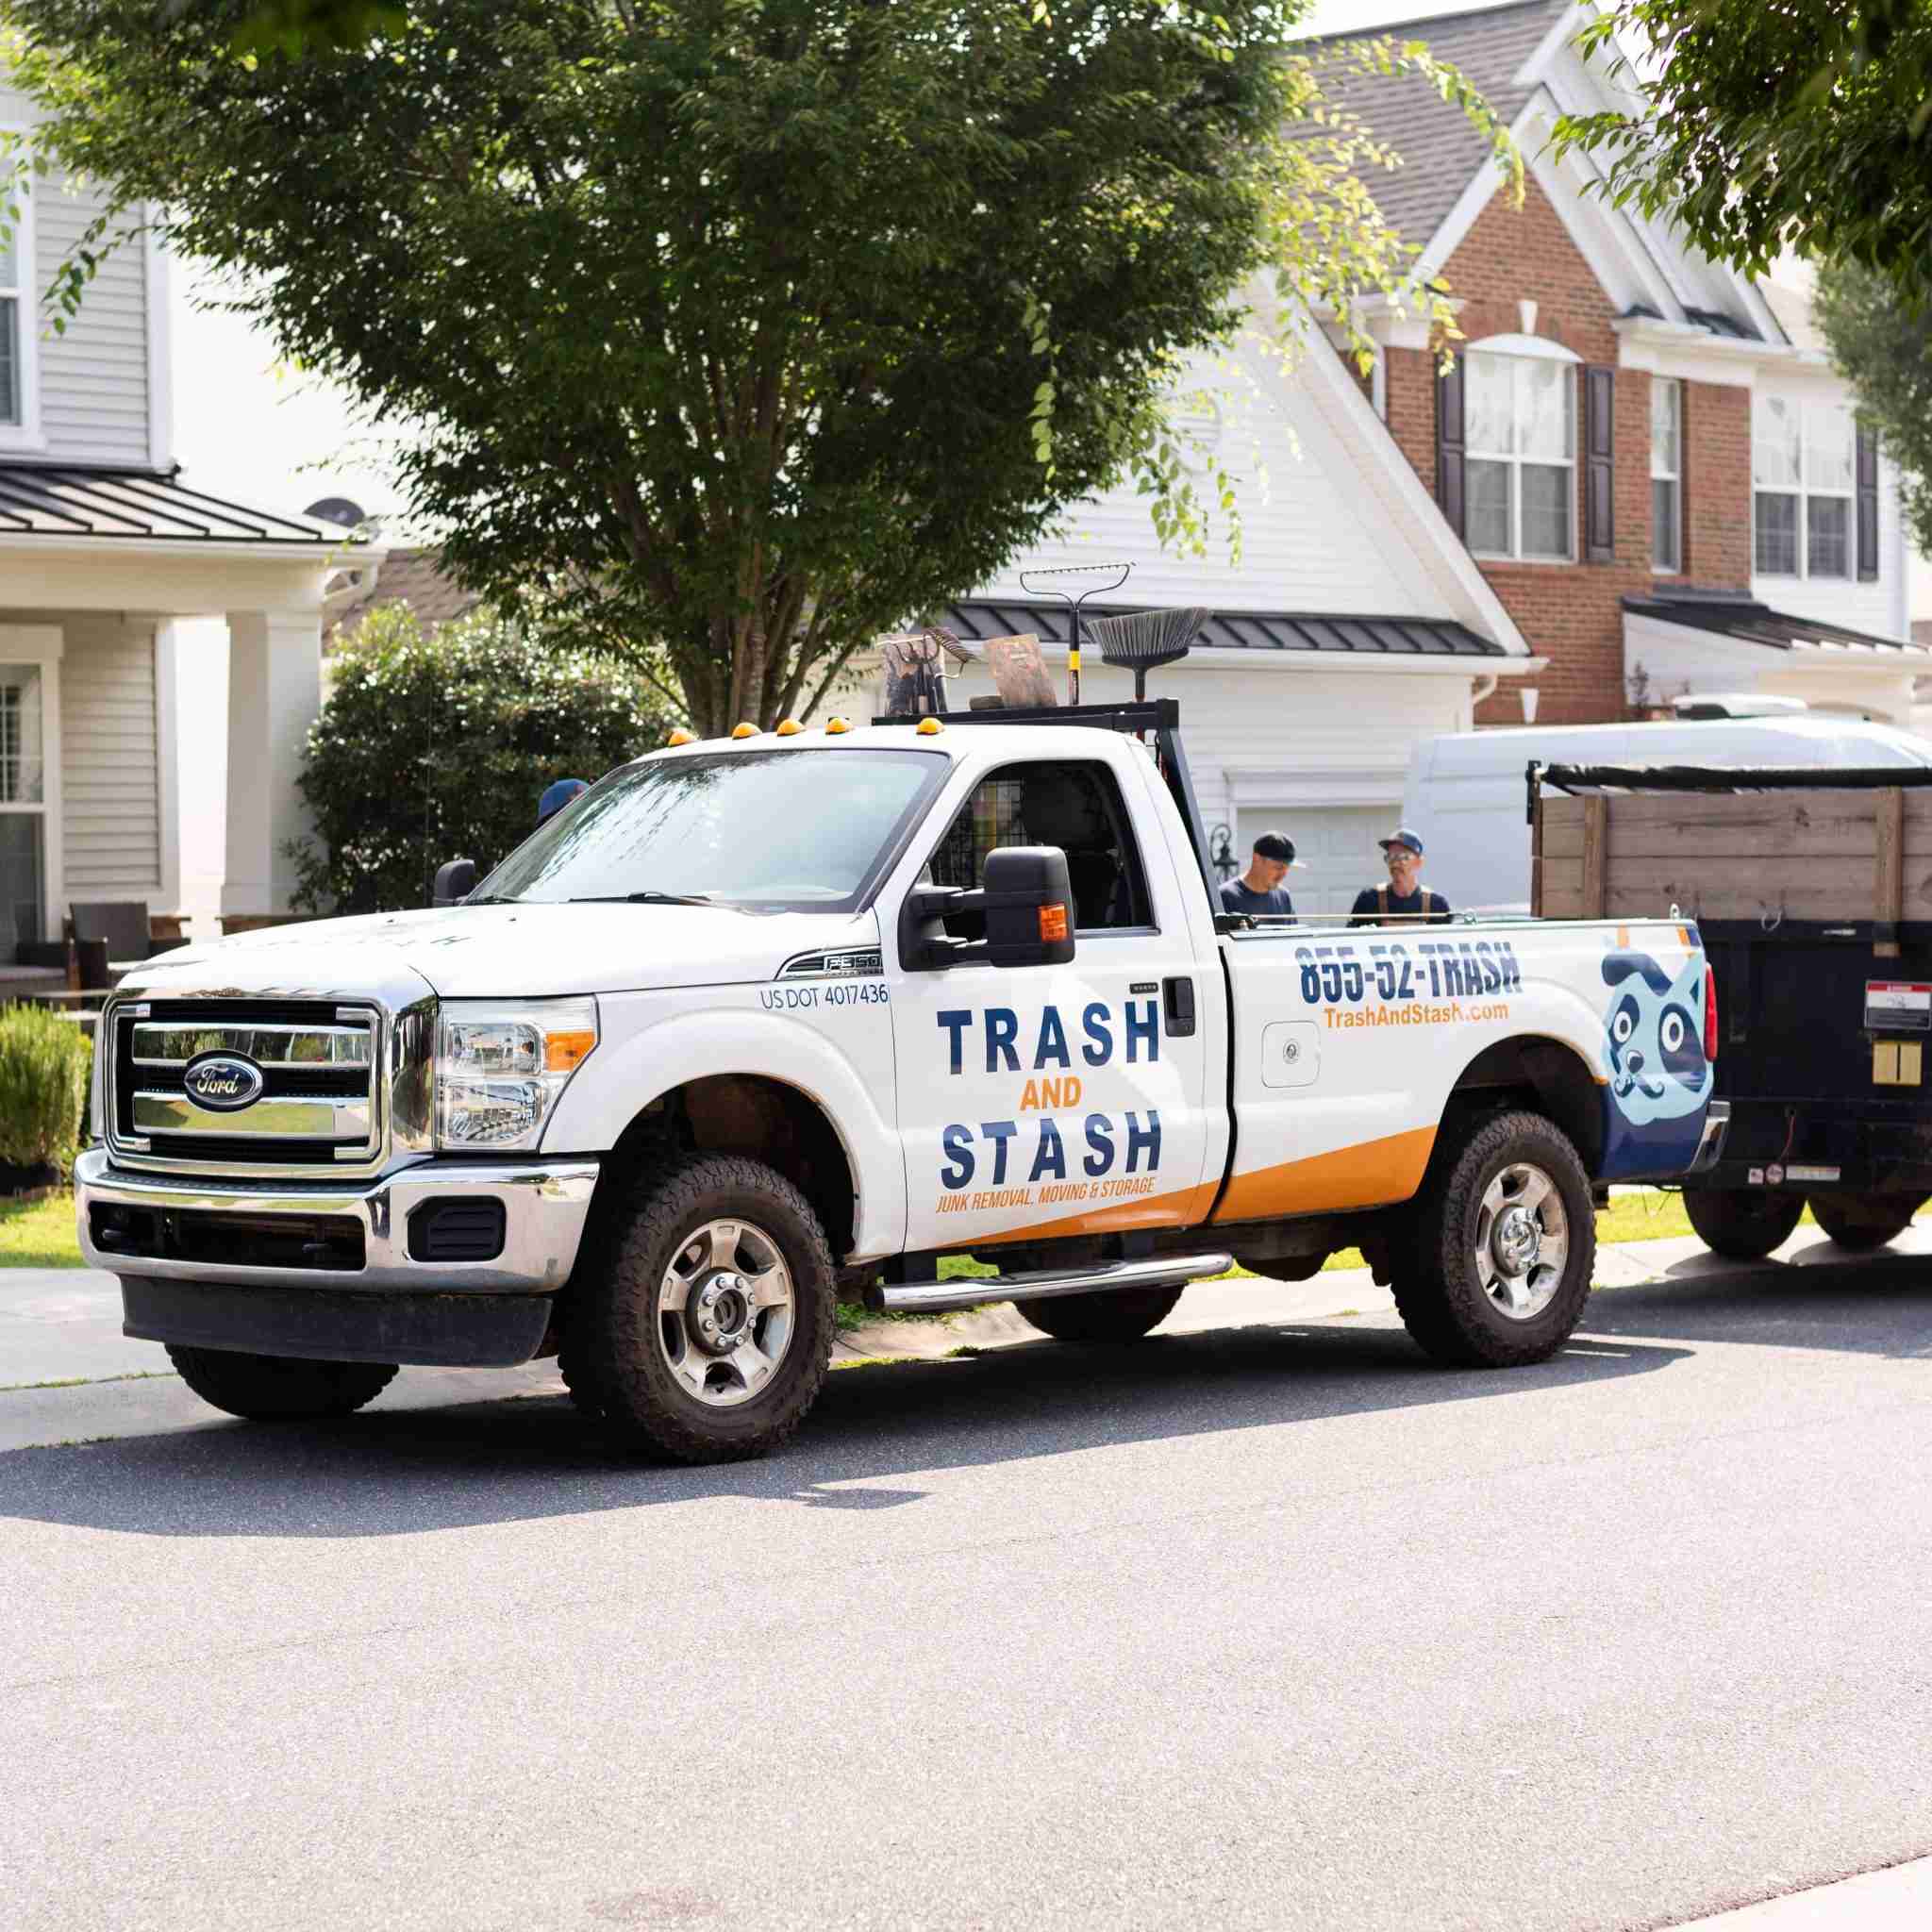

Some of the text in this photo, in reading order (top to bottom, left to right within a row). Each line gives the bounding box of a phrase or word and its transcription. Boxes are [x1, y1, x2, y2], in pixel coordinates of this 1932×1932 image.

[1295, 941, 1523, 1004] 855-52-TRASH
[760, 983, 889, 1009] US DOT 4017436
[1324, 1003, 1508, 1028] TrashAndStash.com
[937, 1000, 1158, 1074] TRASH
[196, 1065, 239, 1093] Ford
[1019, 1076, 1082, 1111] AND
[941, 1110, 1161, 1190] STASH
[936, 1193, 969, 1213] JUNK
[1038, 1182, 1089, 1204] MOVING
[1090, 1181, 1099, 1199] &
[1100, 1176, 1156, 1198] STORAGE
